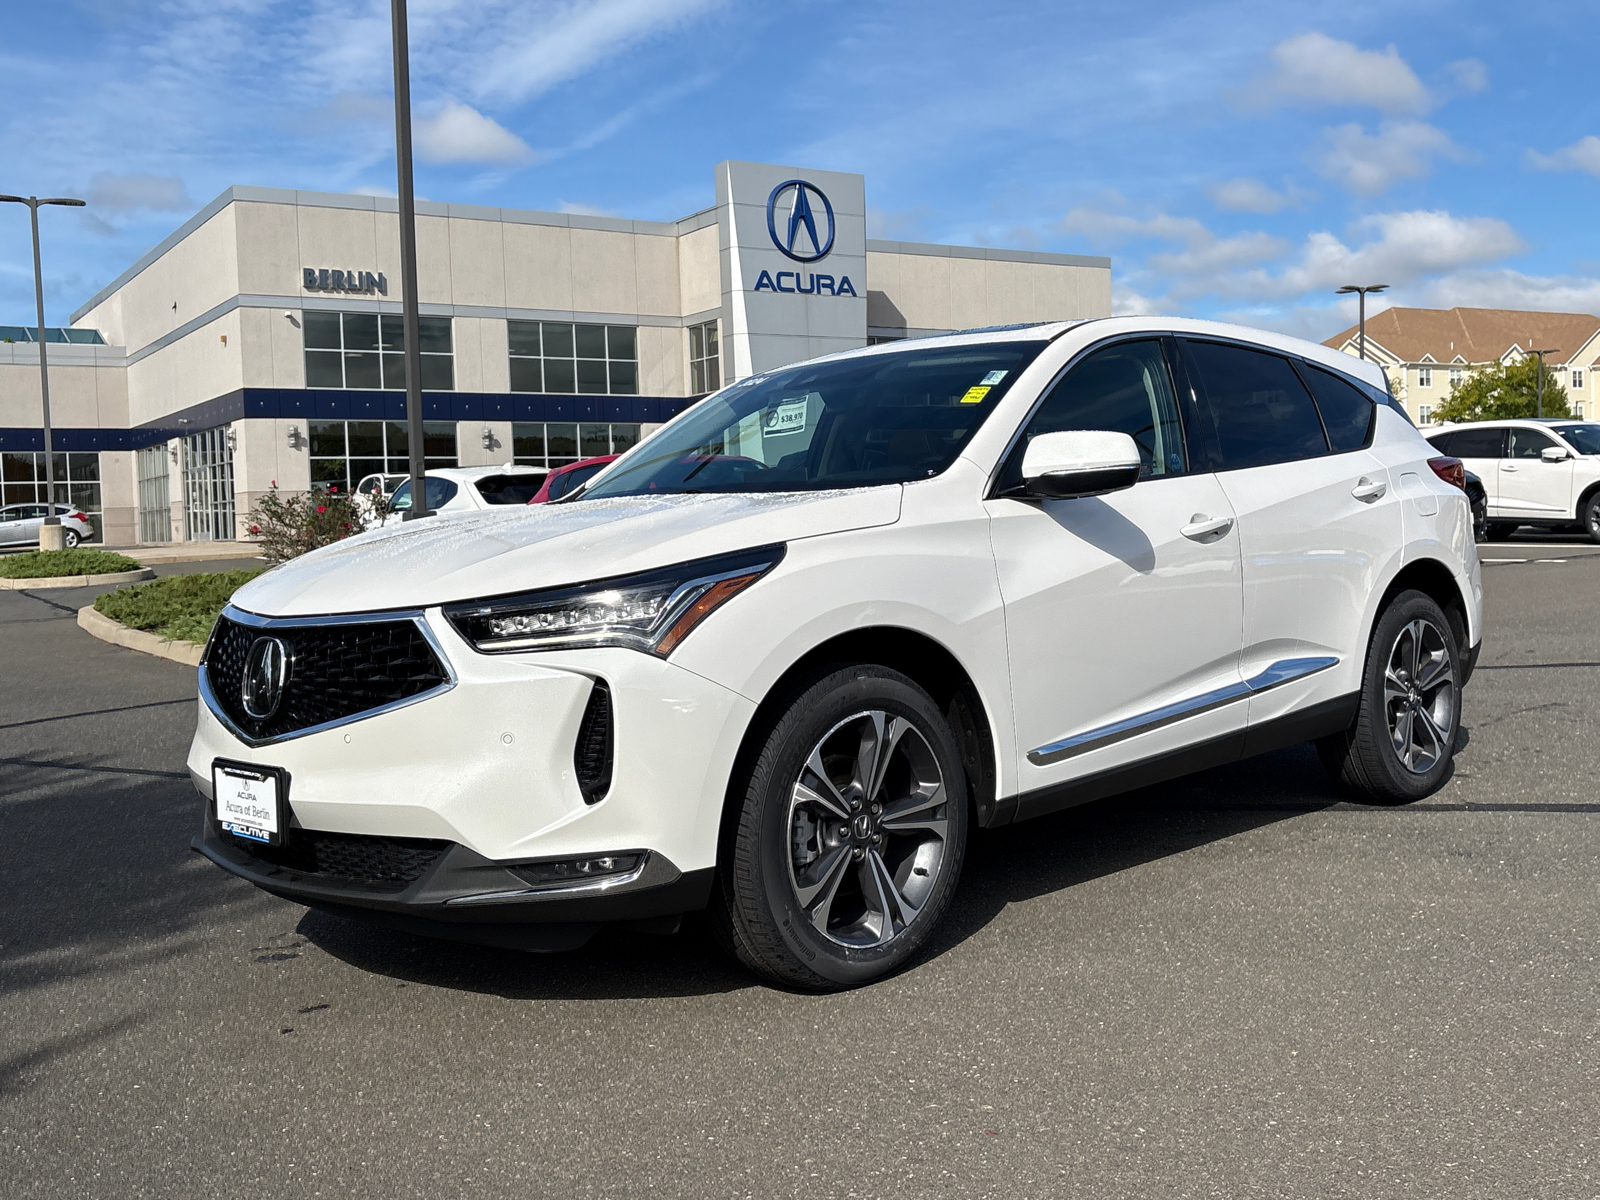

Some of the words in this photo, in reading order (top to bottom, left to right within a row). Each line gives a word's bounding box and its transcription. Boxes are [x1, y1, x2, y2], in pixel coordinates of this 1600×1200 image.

[303, 268, 384, 292] BERLIN
[754, 270, 857, 297] ACURA
[781, 412, 803, 423] $38,970
[237, 791, 257, 801] ACURA
[226, 800, 243, 814] Acura
[244, 805, 251, 815] of
[252, 806, 270, 820] Berlin
[222, 822, 270, 839] EXECUTIVE
